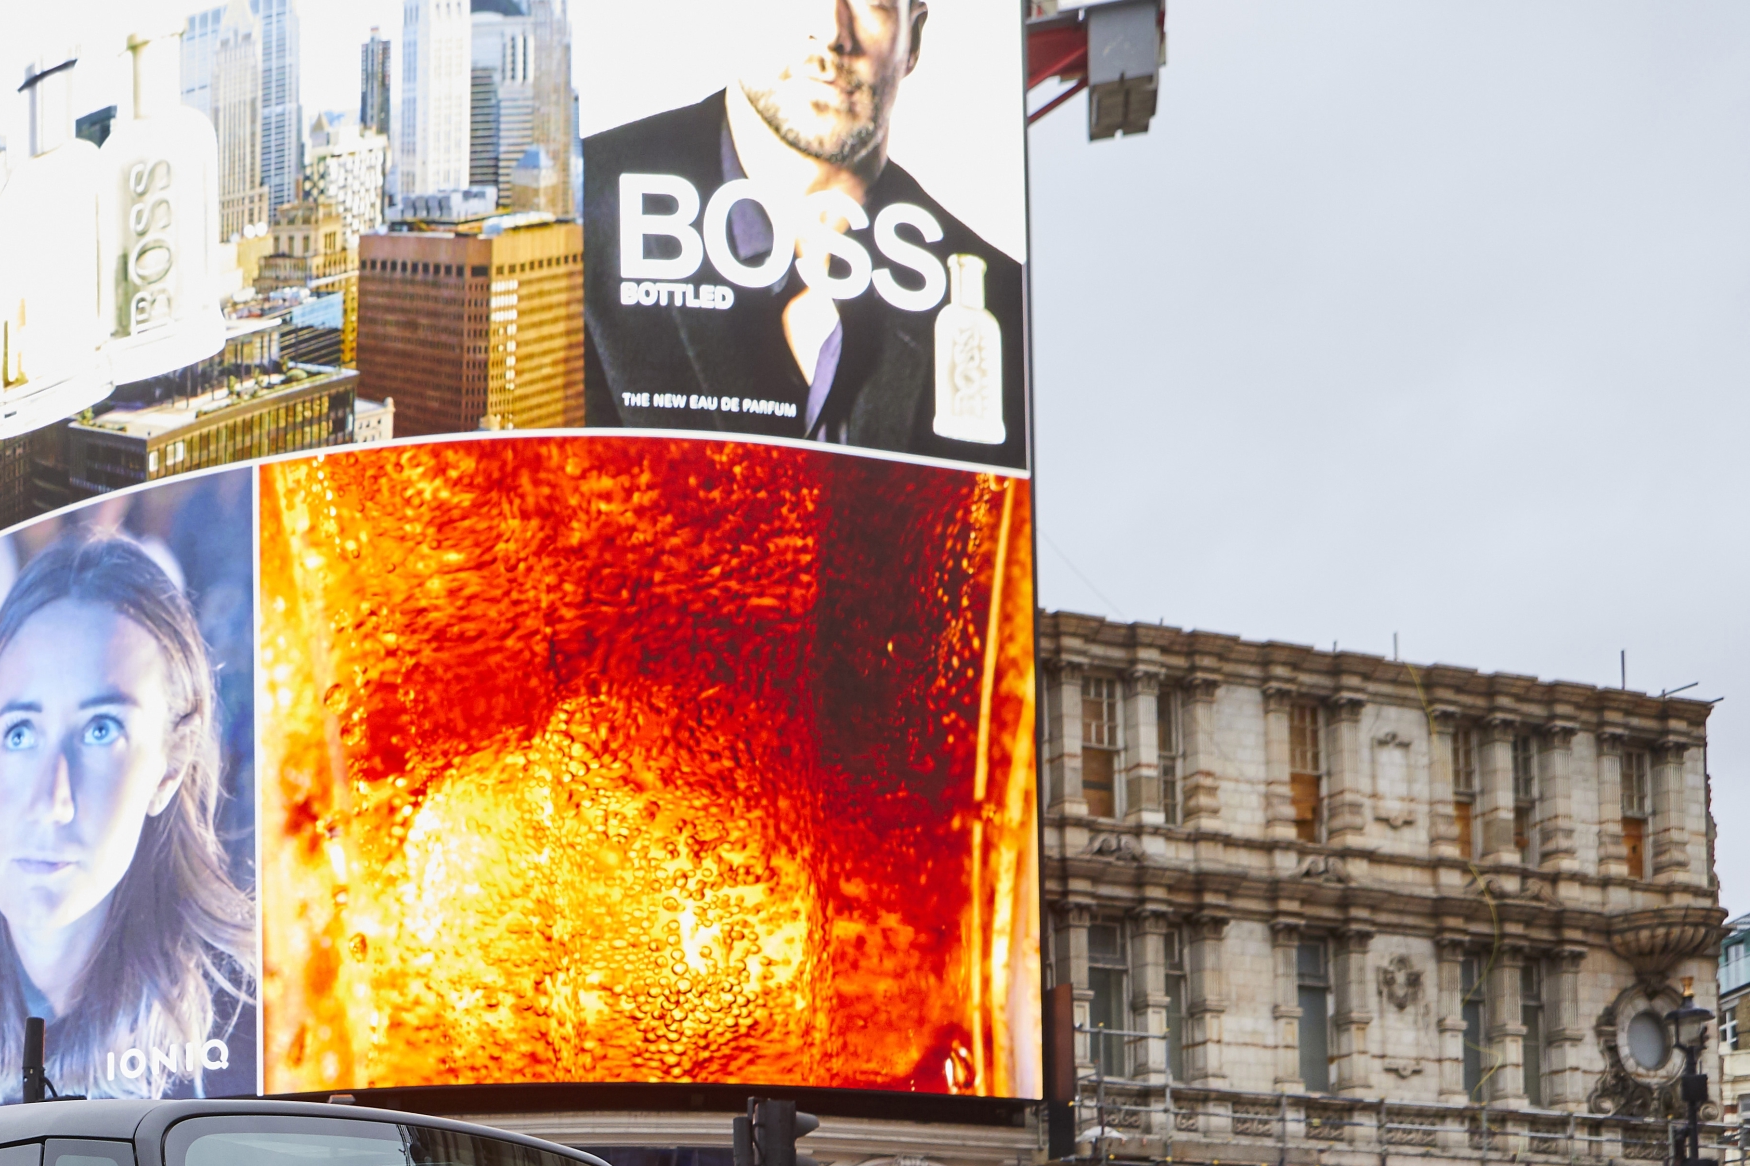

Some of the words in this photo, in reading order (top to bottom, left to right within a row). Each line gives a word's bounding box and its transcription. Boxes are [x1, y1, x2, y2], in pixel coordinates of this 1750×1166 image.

[128, 159, 172, 336] BOSS
[619, 173, 947, 312] BOSS
[620, 281, 735, 310] BOTTLED
[622, 391, 650, 408] THE
[653, 392, 687, 409] NEW
[689, 394, 718, 411] EAU
[721, 396, 740, 412] DE
[742, 398, 797, 418] PARFUM
[107, 1039, 229, 1081] IONIQ
